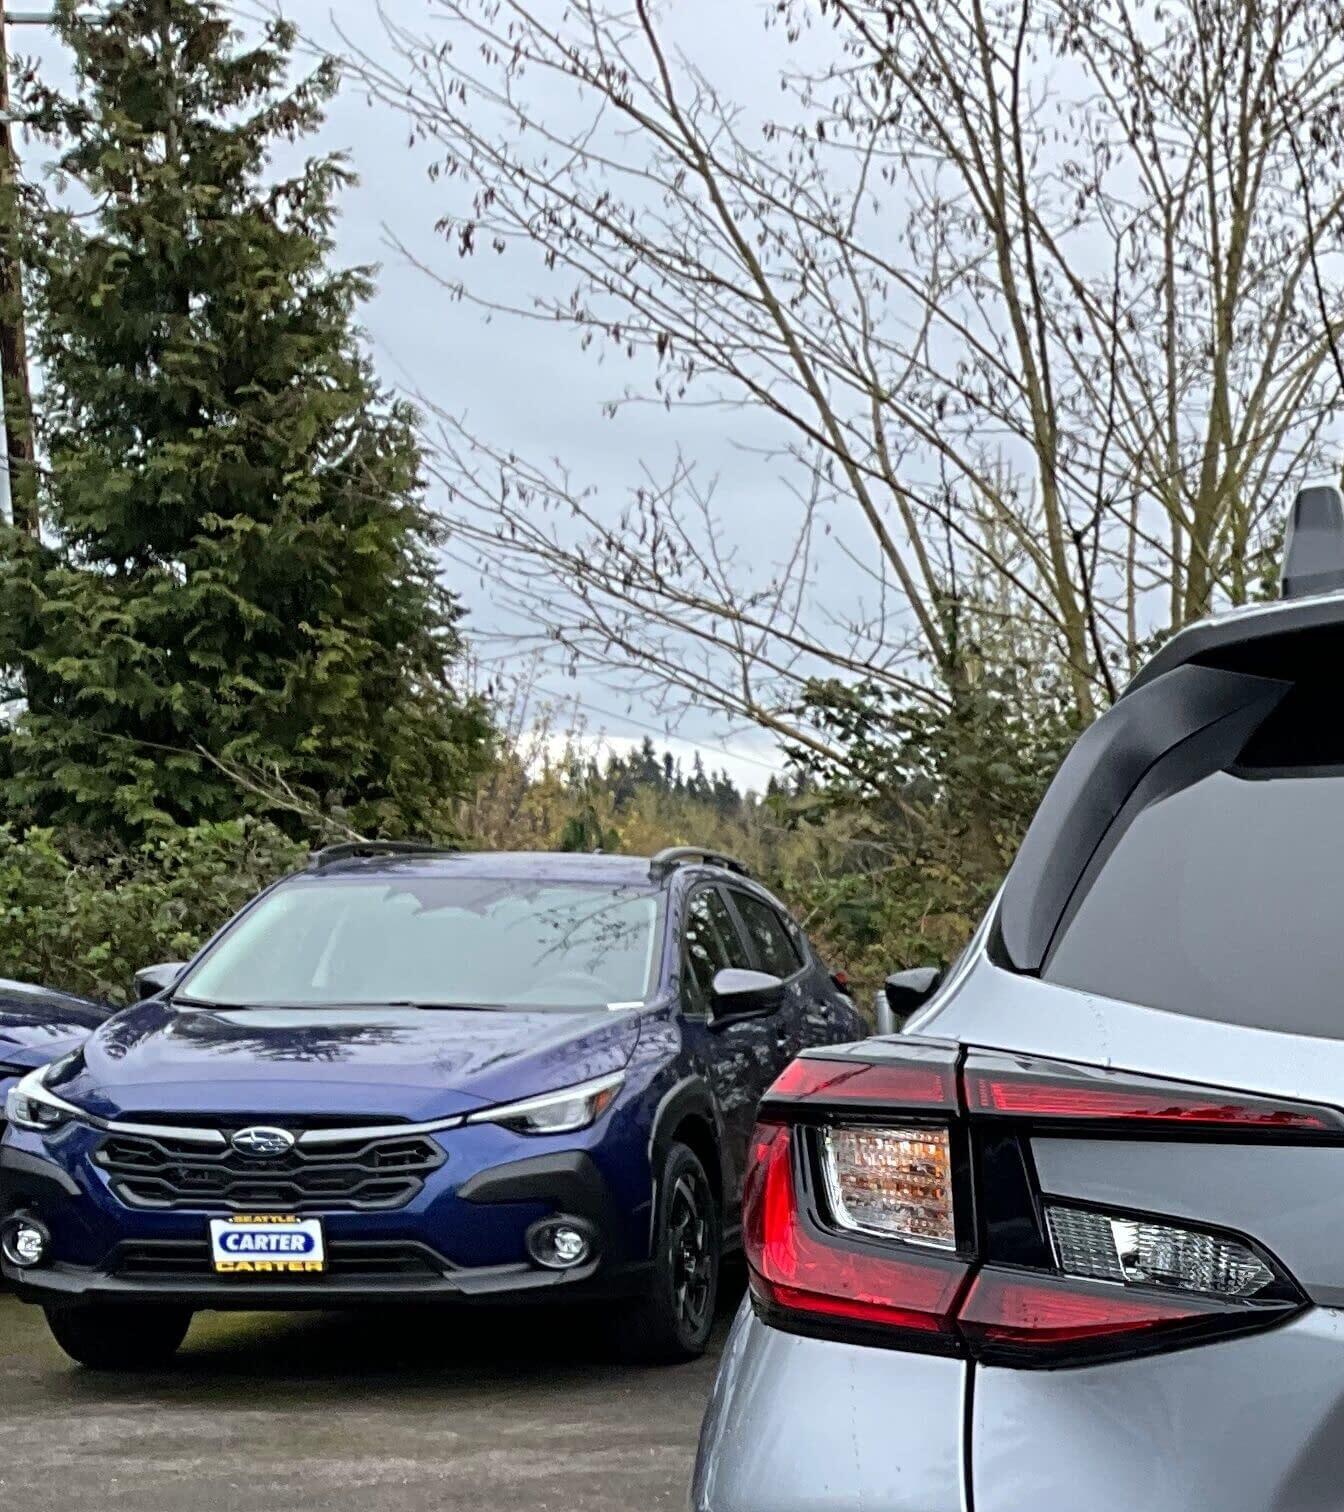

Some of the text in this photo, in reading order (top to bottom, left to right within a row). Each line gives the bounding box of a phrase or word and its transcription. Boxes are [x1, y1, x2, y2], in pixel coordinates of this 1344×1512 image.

[233, 1215, 296, 1224] SEATTLE
[226, 1233, 306, 1251] CARTER
[215, 1261, 323, 1272] CARTER
